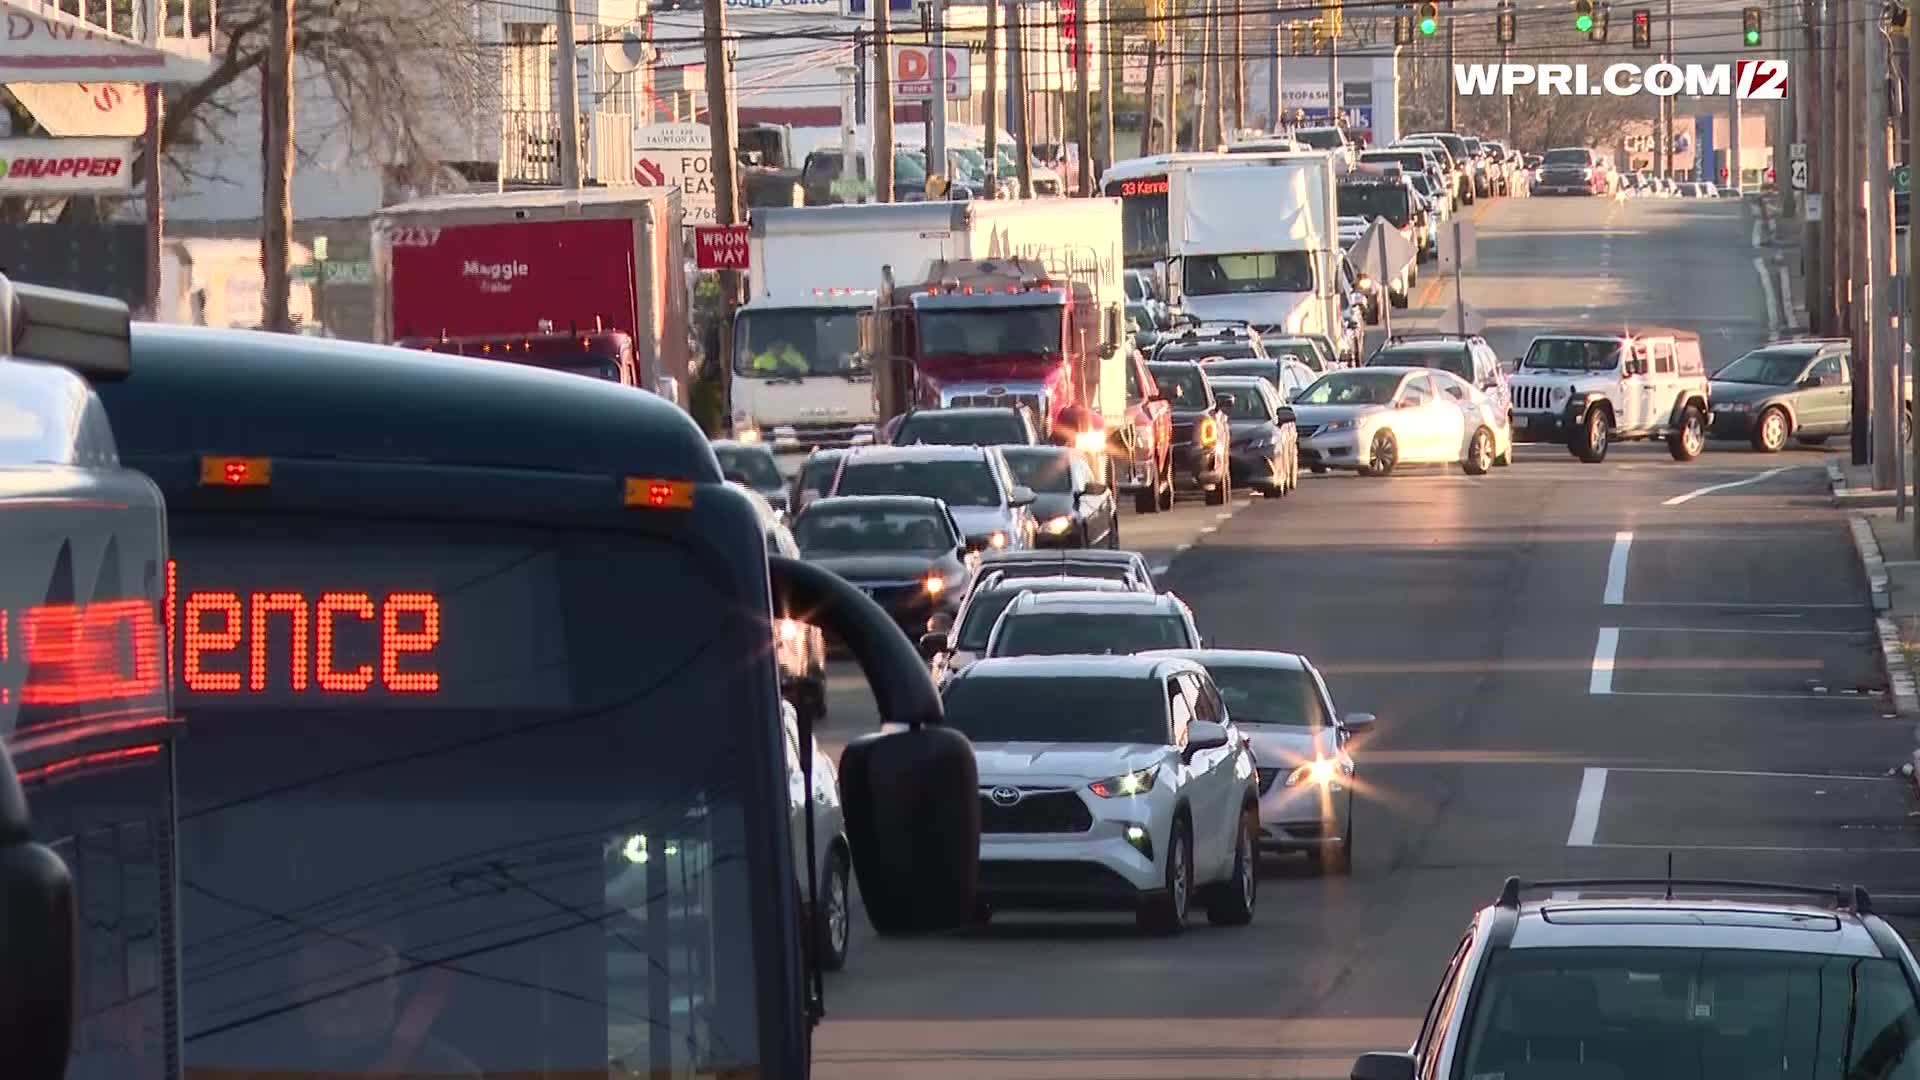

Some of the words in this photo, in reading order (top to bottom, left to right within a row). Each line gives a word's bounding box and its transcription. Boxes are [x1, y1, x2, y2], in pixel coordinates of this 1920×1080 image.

[8, 157, 121, 177] SNAPPER
[681, 157, 713, 173] FO
[1122, 183, 1136, 195] 33
[713, 249, 745, 263] WAY
[166, 560, 441, 692] ence
